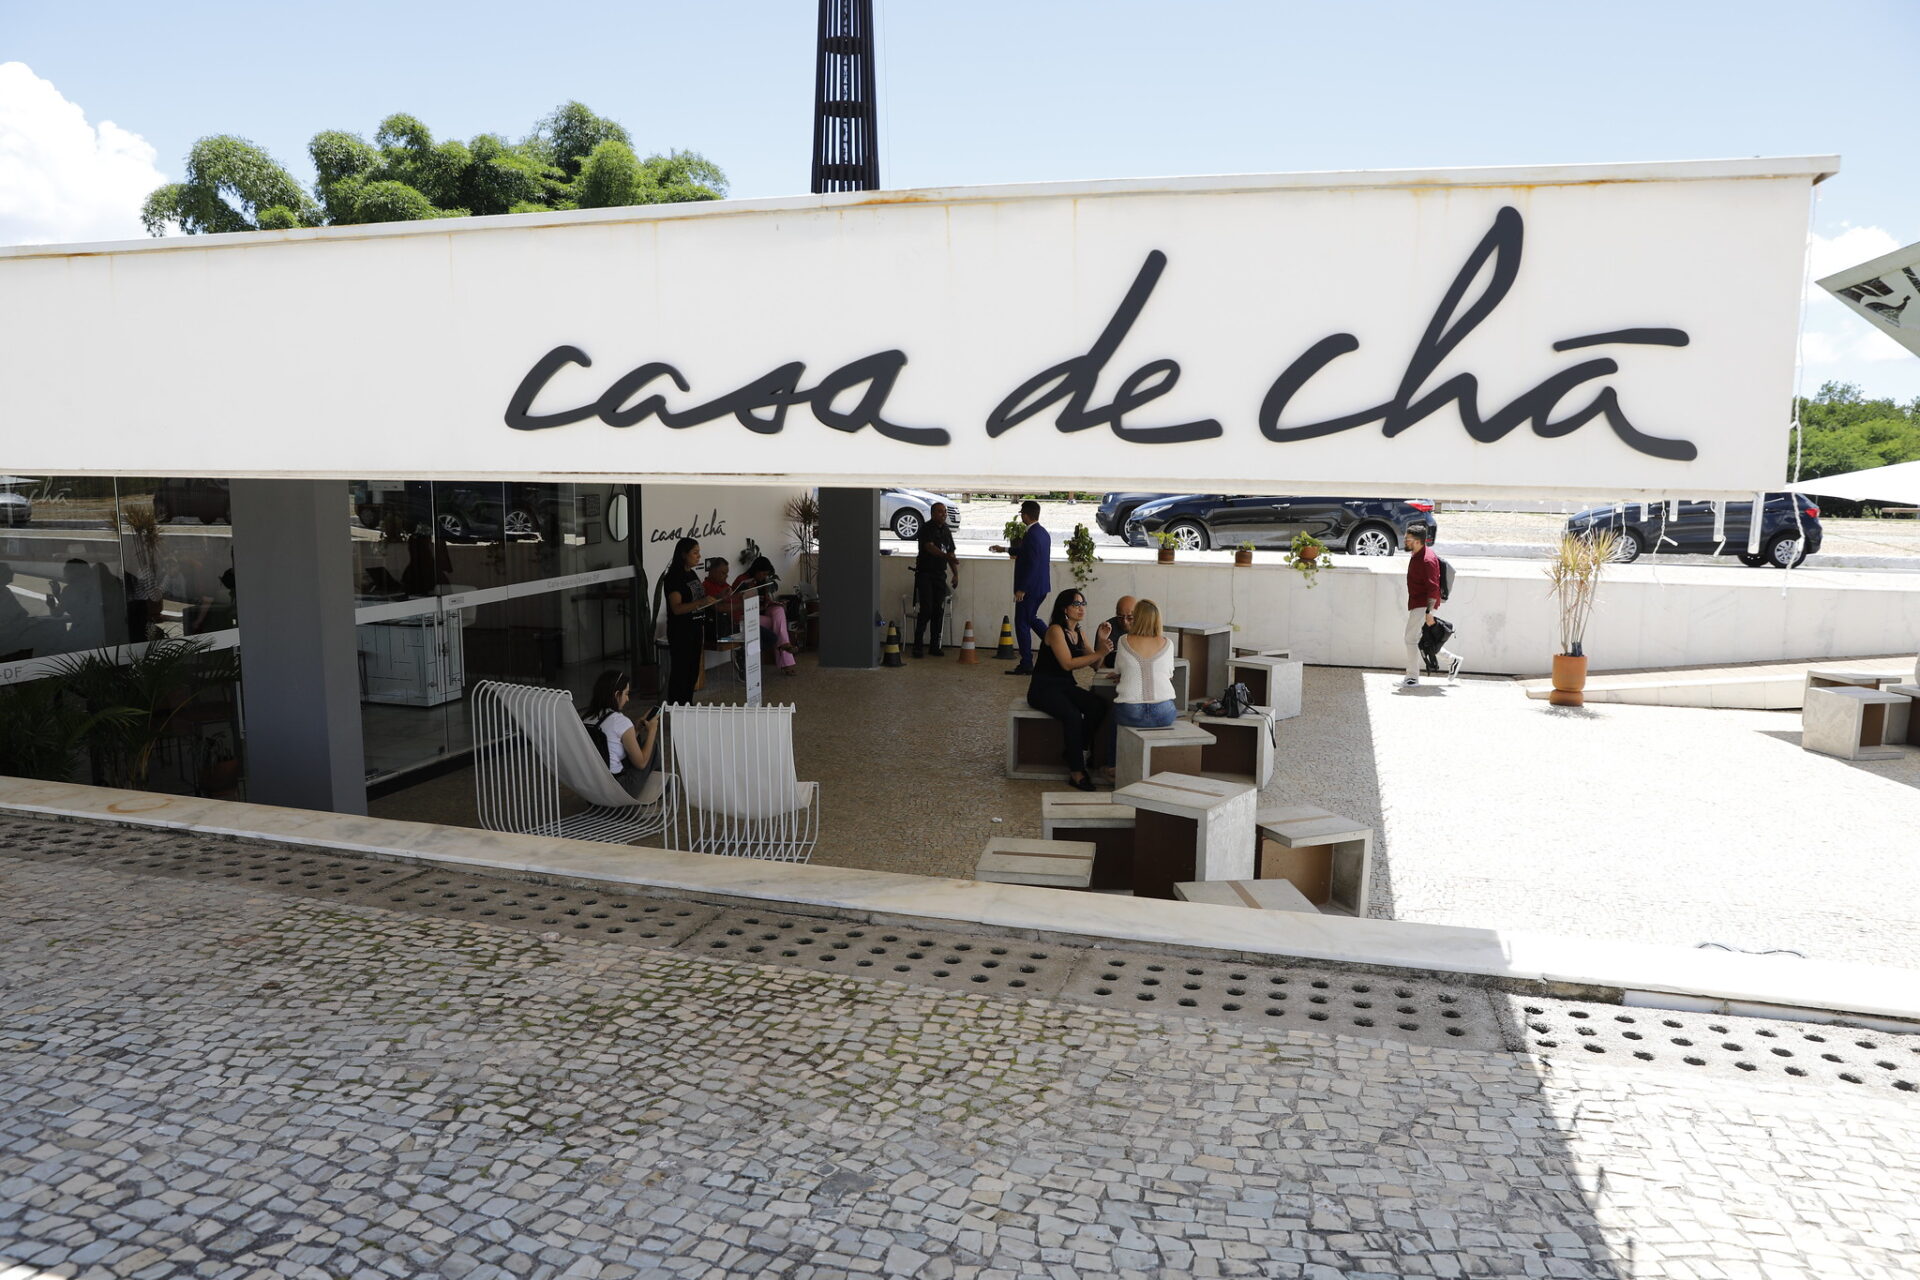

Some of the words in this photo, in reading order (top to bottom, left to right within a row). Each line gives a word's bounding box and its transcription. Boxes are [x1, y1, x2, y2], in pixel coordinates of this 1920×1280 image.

[505, 346, 950, 446] casa
[986, 250, 1222, 443] de
[651, 527, 683, 543] casa
[687, 514, 702, 539] de
